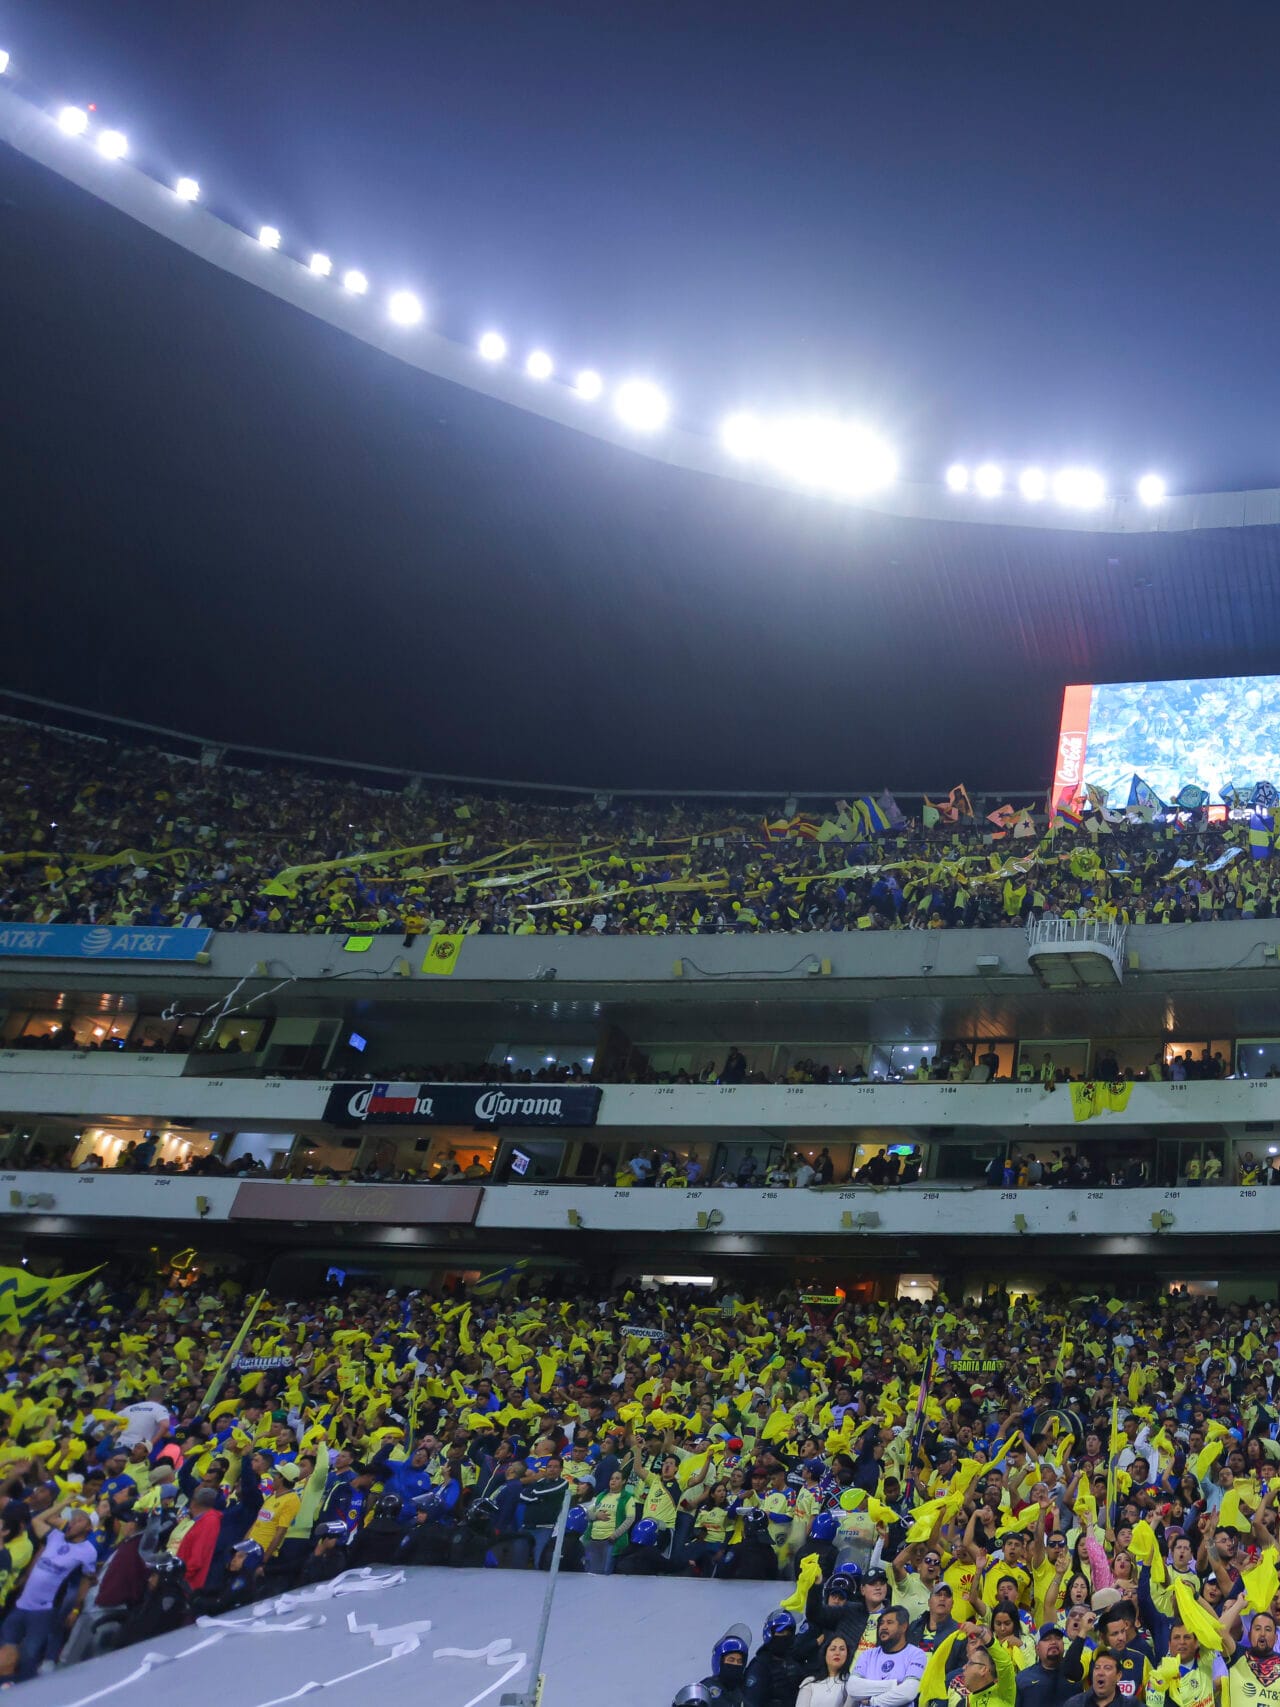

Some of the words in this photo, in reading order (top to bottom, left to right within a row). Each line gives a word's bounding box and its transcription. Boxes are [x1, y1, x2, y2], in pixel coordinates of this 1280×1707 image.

[111, 934, 174, 951] AT&T
[347, 1089, 434, 1121] Cna
[474, 1090, 563, 1122] Corona
[686, 1191, 702, 1199] 2187
[839, 1192, 856, 1200] 2185
[923, 1192, 940, 1200] 2184
[1000, 1192, 1017, 1200] 2183
[1164, 1191, 1180, 1199] 2181
[957, 1360, 980, 1372] SANTA
[982, 1360, 996, 1372] ANA
